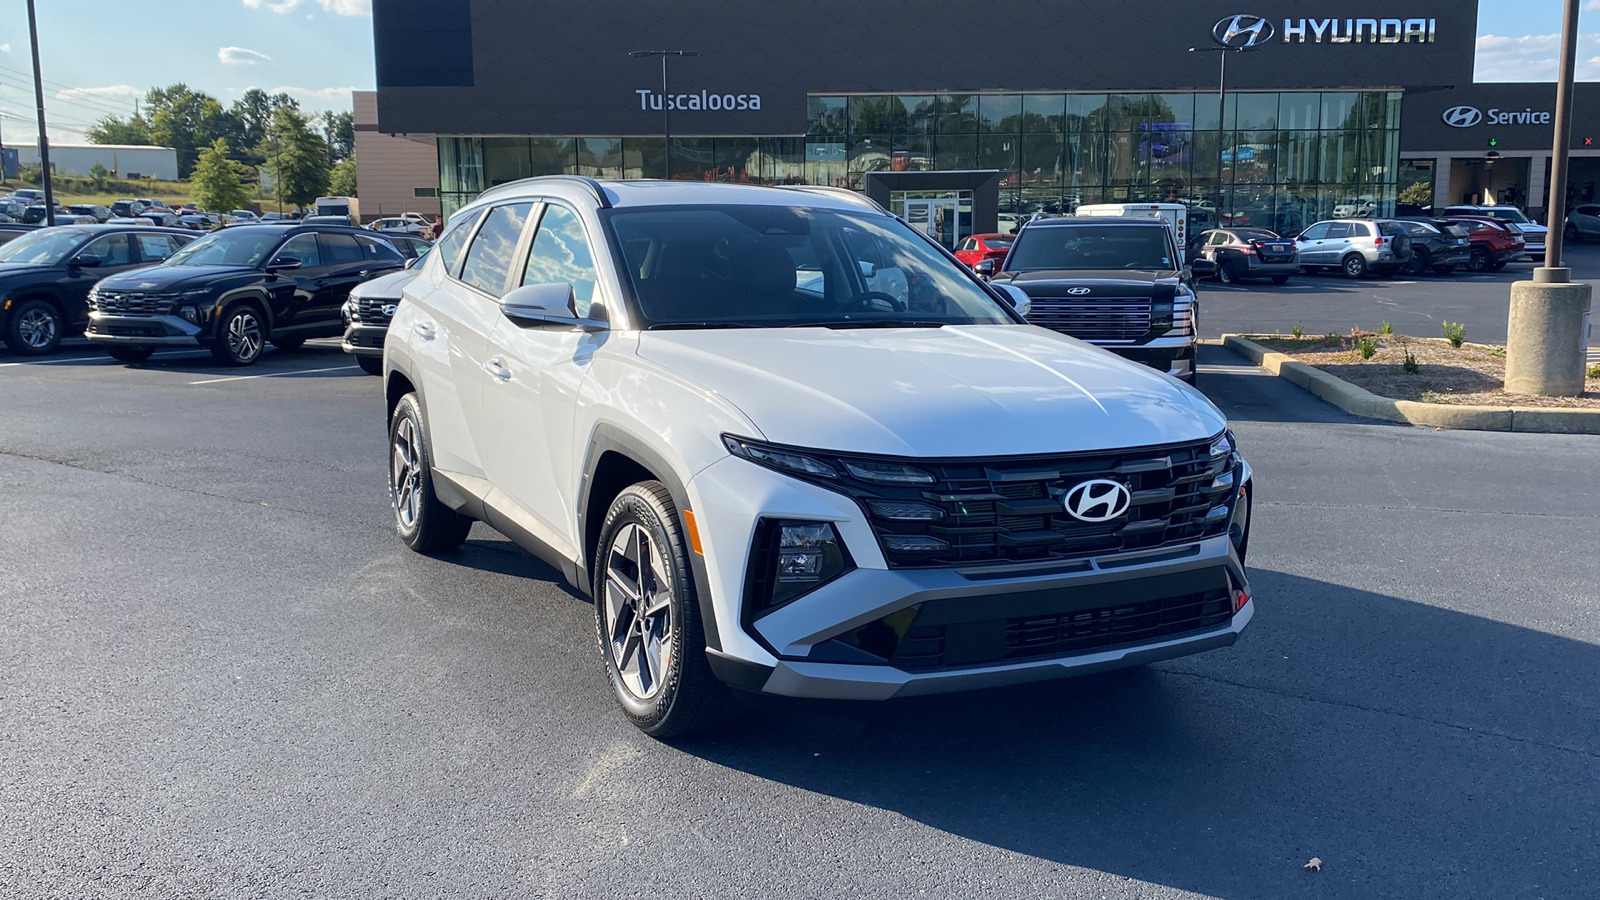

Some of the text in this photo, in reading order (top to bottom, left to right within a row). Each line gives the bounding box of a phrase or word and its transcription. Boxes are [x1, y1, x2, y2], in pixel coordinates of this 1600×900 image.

[1283, 18, 1436, 43] HYUNDAI
[635, 89, 761, 111] Tuscaloosa
[1486, 107, 1550, 125] Service
